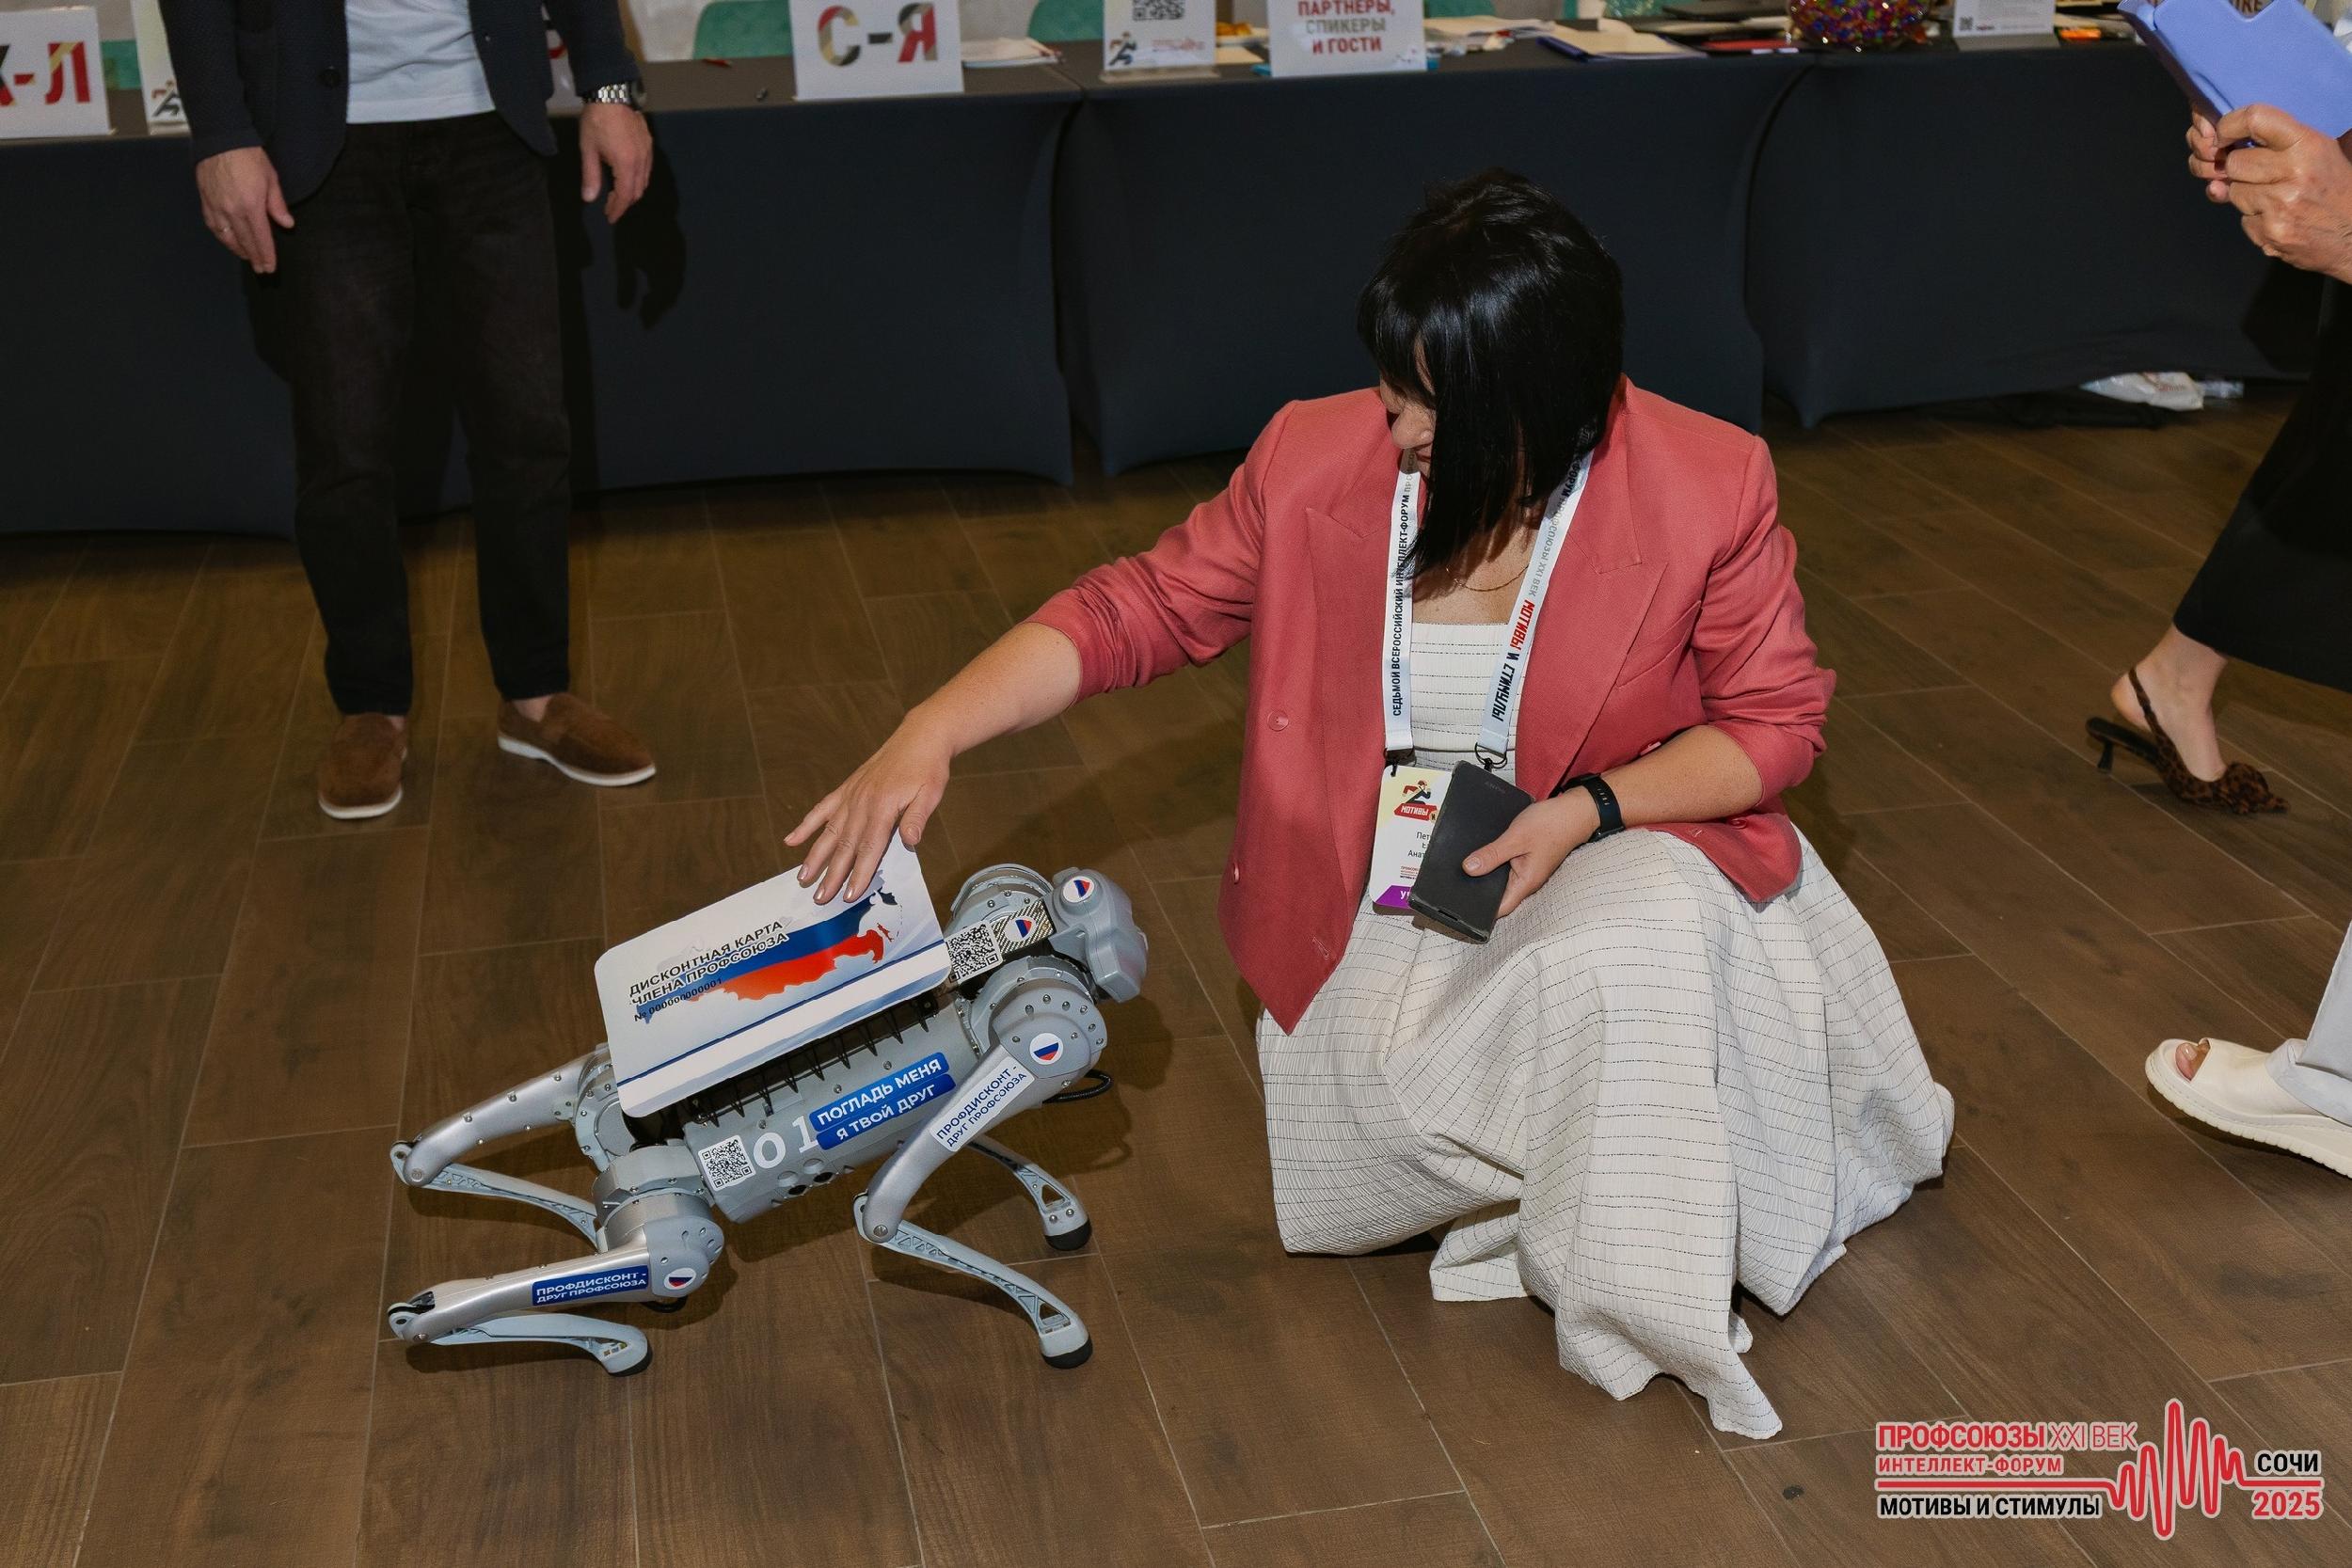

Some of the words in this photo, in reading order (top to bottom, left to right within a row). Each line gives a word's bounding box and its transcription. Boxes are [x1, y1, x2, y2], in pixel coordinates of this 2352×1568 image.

[818, 3, 938, 66] С-Я
[1306, 17, 1386, 34] СПИКЕРЫ
[1312, 40, 1323, 54] И
[1327, 36, 1382, 54] ГОСТИ
[1528, 578, 1541, 597] ВЕК
[1391, 588, 1404, 669] ВСЕРОССИЙСКИЙ
[1510, 599, 1535, 651] МОТИВЫ
[1506, 652, 1520, 661] И
[1391, 672, 1403, 716] СЕДЬМОЙ
[1491, 662, 1516, 722] СТИМУЛЫ
[1400, 805, 1429, 816] МОТИВЫ
[629, 943, 731, 997] ДИСКОНТНАЯ
[735, 921, 783, 948] КАРТА
[631, 979, 684, 1006] ЧЛЕНА
[686, 933, 788, 983] ПРОФСОЮЗА
[817, 1085, 893, 1126] ПОГЛАДЬ
[895, 1058, 941, 1089] МЕНЯ
[836, 1129, 849, 1141] Я
[849, 1104, 894, 1134] ТВОЙ
[898, 1084, 934, 1114] ДРУГ
[936, 1068, 1011, 1140] ПРОФДИСКОНТ
[946, 1122, 969, 1148] ДРУГ
[968, 1072, 1027, 1125] ПРОФСОЮЗА
[536, 1272, 639, 1296] ПРОФДИСКОНТ
[536, 1292, 567, 1304] ДРУГ
[568, 1279, 646, 1297] ПРОФСОЮЗА
